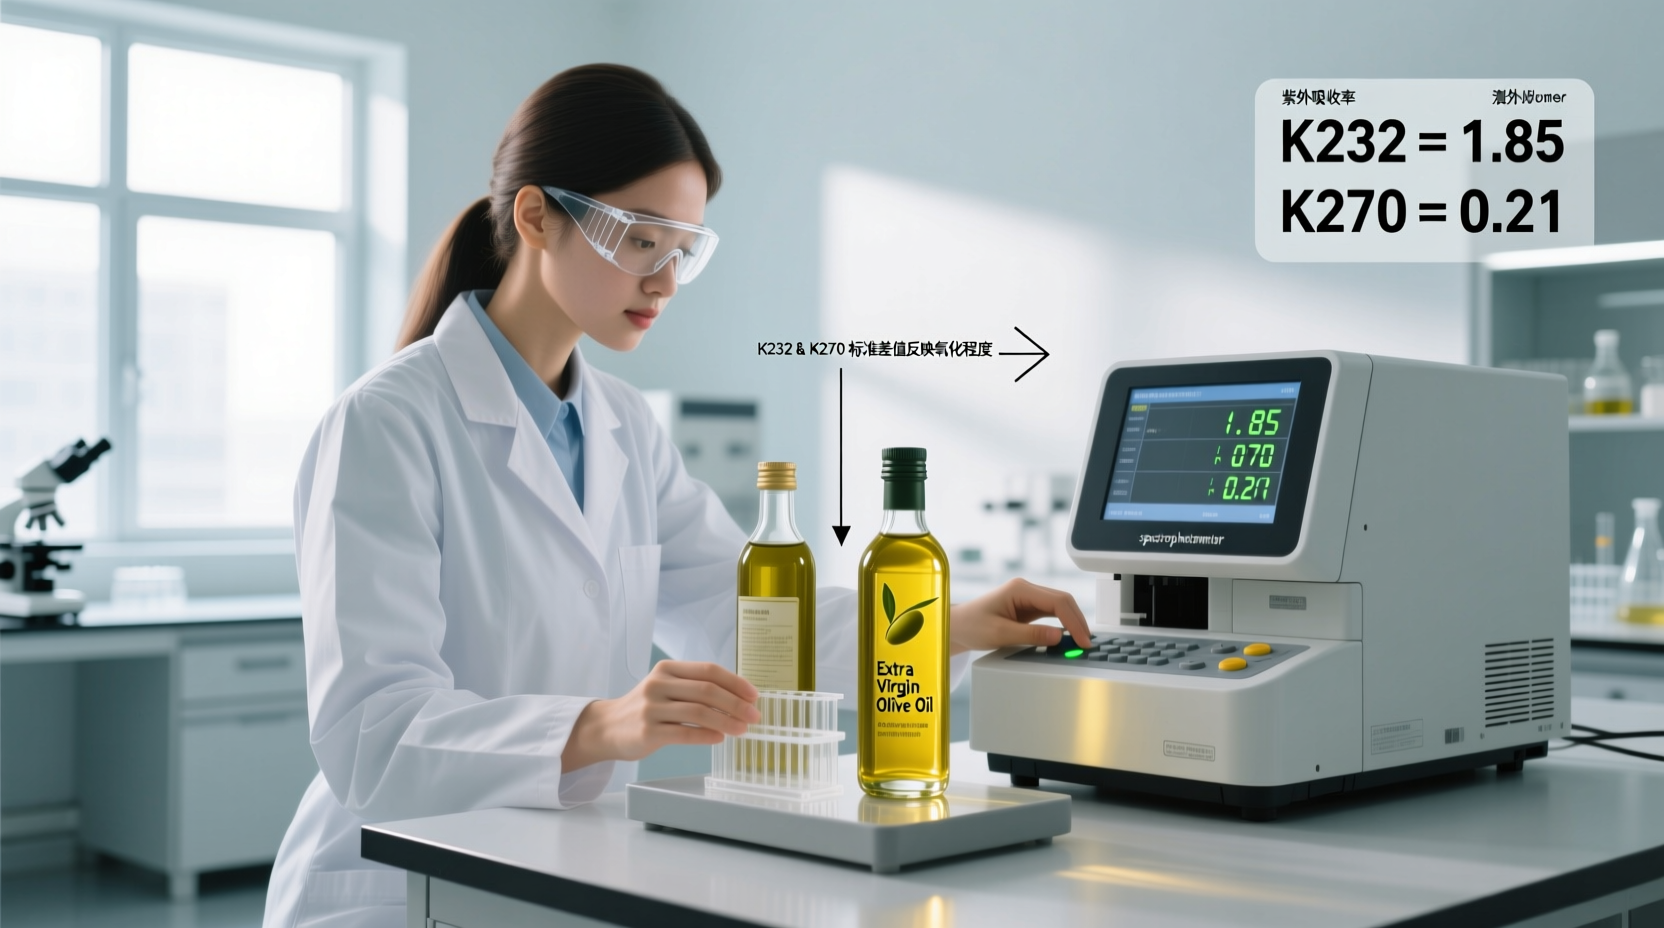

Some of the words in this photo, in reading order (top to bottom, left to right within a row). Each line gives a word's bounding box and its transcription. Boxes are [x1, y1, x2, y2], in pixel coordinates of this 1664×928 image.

[1225, 408, 1282, 436] 1.85
[877, 660, 914, 676] Extra
[876, 678, 920, 698] Virgin
[876, 697, 911, 713] Olive
[915, 696, 933, 713] Oil
